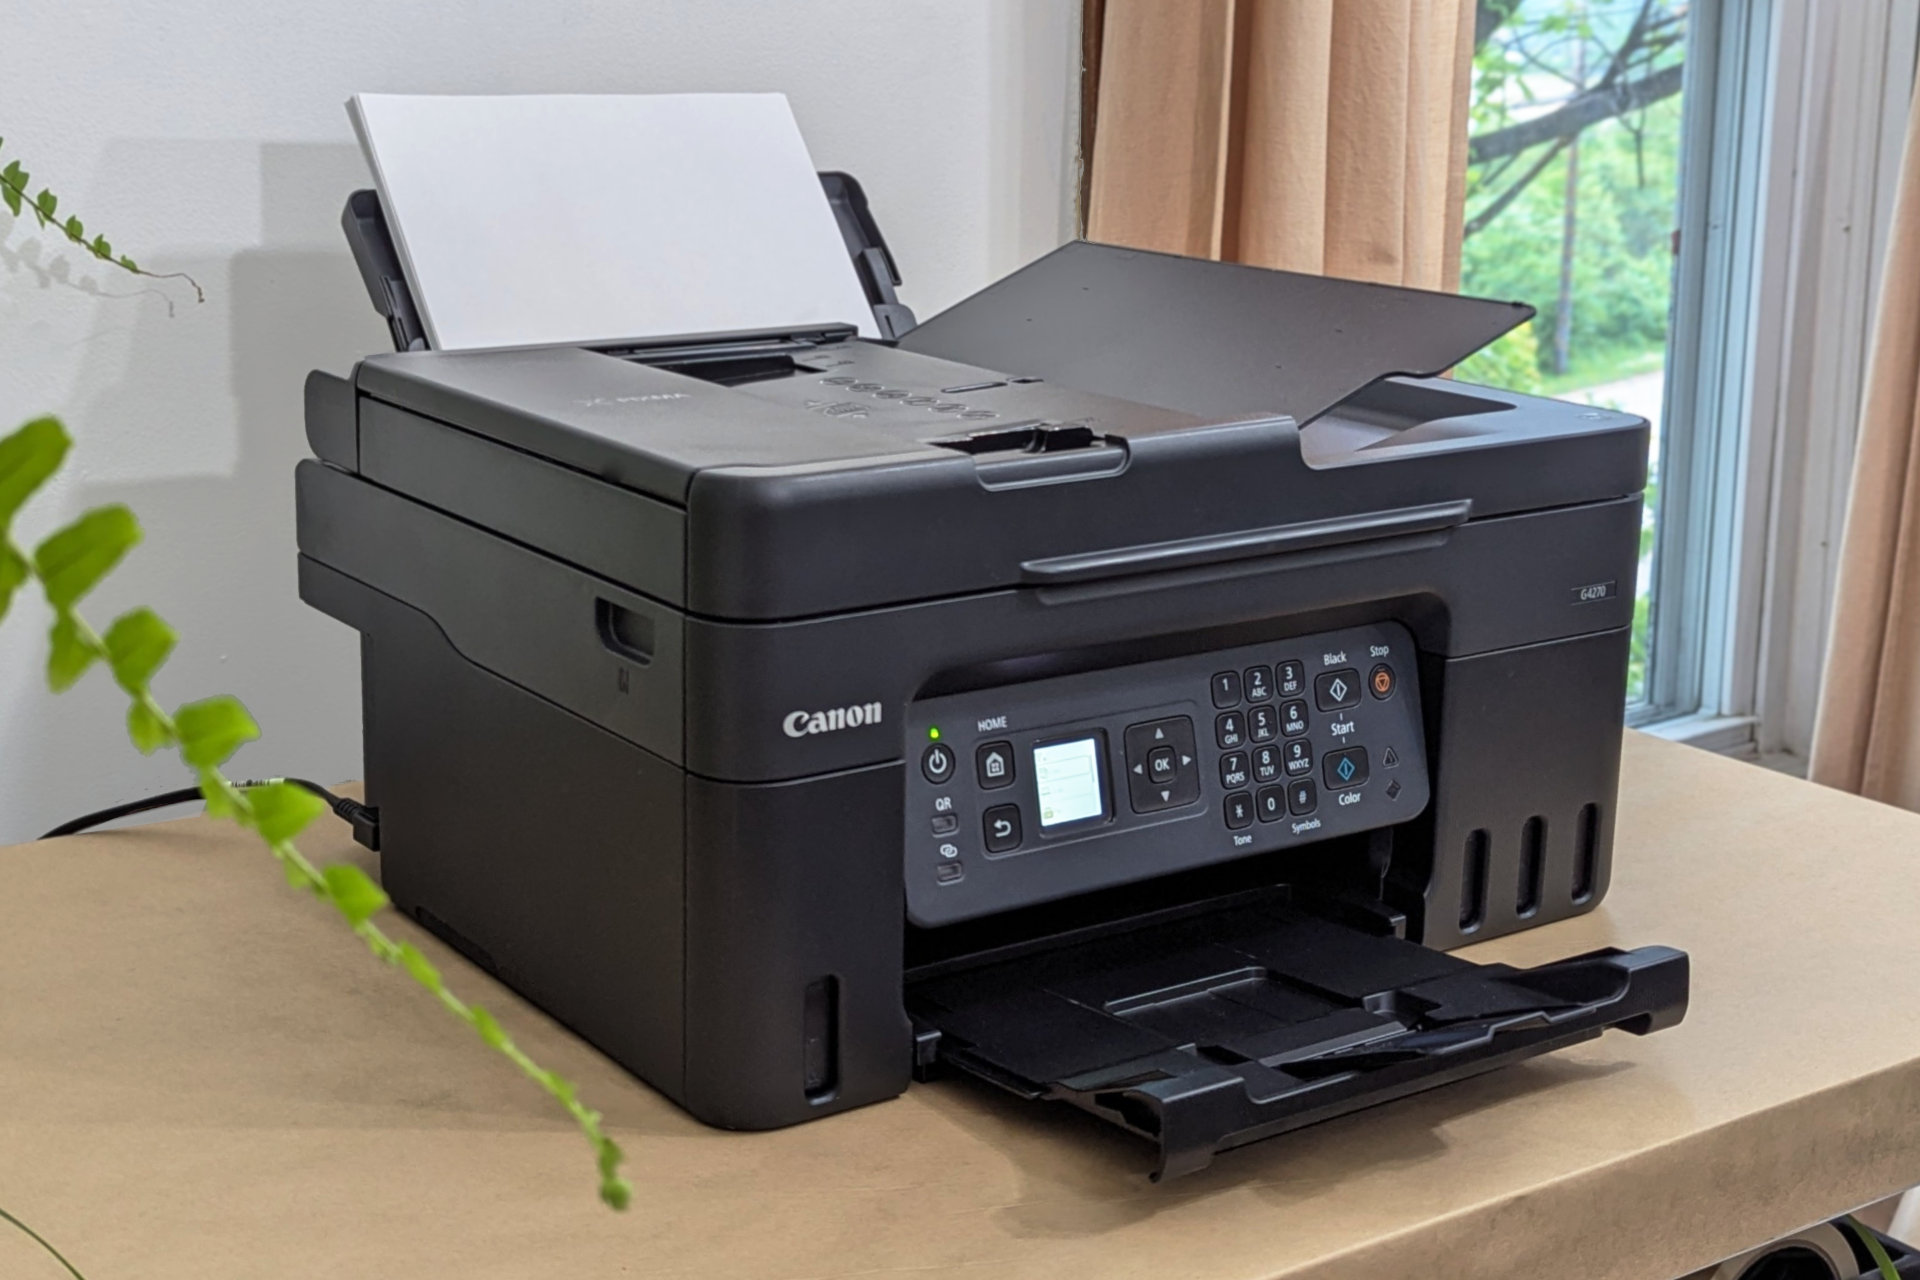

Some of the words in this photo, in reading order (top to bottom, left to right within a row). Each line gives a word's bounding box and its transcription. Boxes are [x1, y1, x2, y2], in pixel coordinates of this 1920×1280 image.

[1580, 585, 1606, 600] G4270
[1323, 651, 1347, 666] Black
[1370, 645, 1389, 658] Stop
[1254, 672, 1262, 685] 2
[1285, 666, 1293, 680] 3
[1222, 678, 1229, 691] 1
[1284, 681, 1297, 691] DEF
[1251, 687, 1267, 697] ABC
[1290, 705, 1298, 719] 6
[782, 701, 882, 738] Canon
[977, 715, 1008, 732] HOME
[1225, 718, 1234, 732] 4
[1258, 713, 1266, 726] 5
[1286, 721, 1304, 731] MNO
[1257, 727, 1269, 738] JKL
[1330, 722, 1355, 736] Start
[1224, 733, 1238, 744] GHI
[1262, 750, 1270, 764] 8
[1293, 744, 1301, 758] 9
[1154, 757, 1170, 772] OK
[1230, 757, 1238, 771] 7
[1260, 765, 1274, 776] TUV
[1288, 758, 1309, 771] WXYZ
[1226, 772, 1245, 784] PQRS
[935, 797, 952, 811] QR
[1267, 798, 1275, 811] 0
[1338, 792, 1361, 806] Color
[1292, 818, 1321, 835] Symbols
[1233, 835, 1252, 847] Tone
